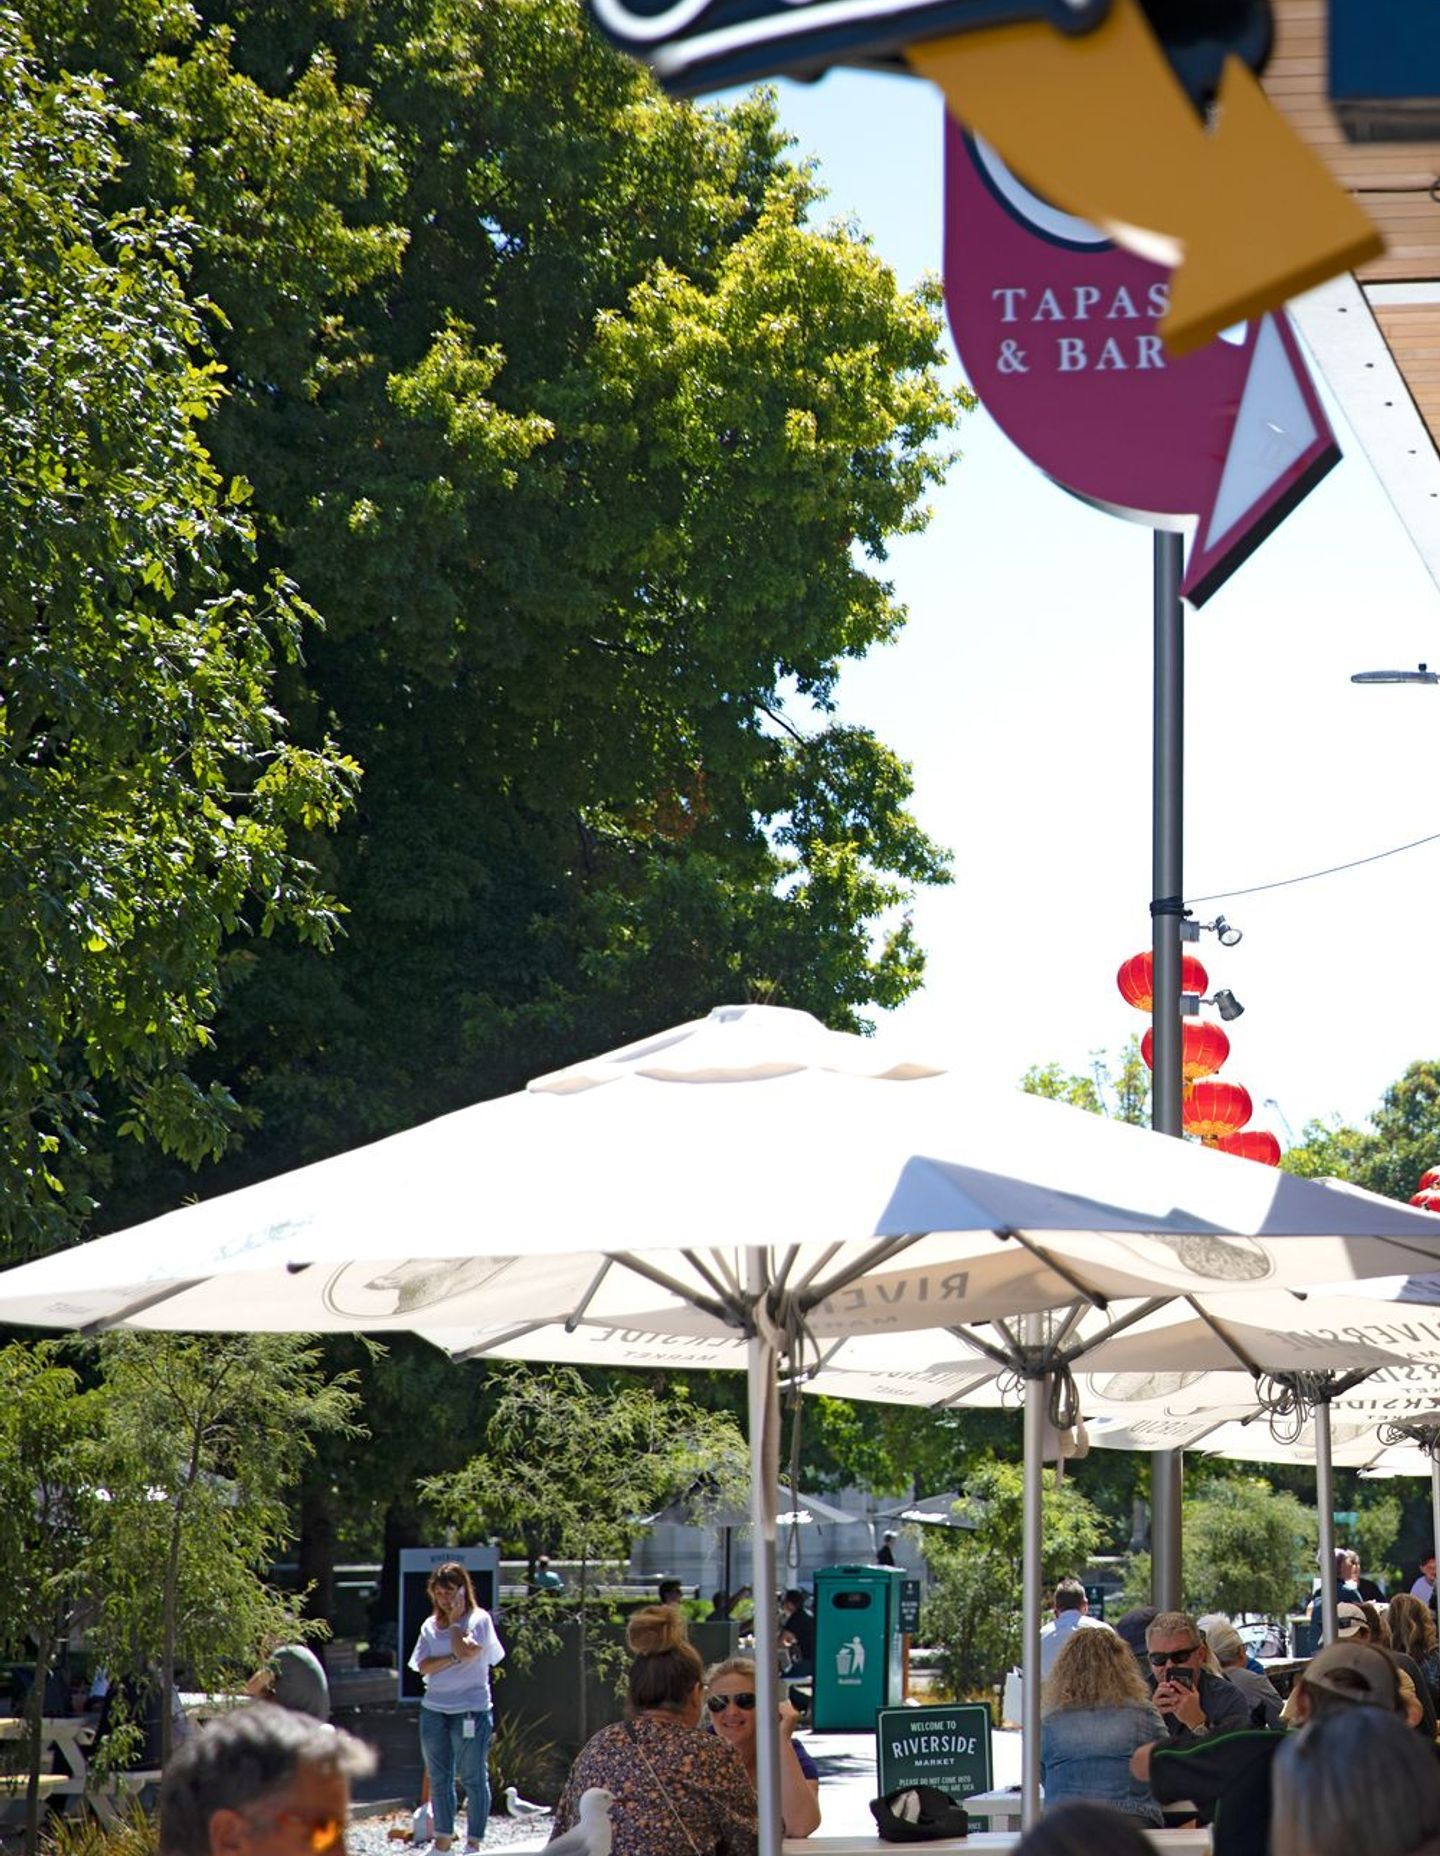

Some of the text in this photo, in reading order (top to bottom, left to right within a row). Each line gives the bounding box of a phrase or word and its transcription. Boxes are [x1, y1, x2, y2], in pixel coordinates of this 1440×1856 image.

[992, 283, 1172, 322] TAPAS
[996, 335, 1167, 374] & BAR
[910, 1720, 957, 1732] WELCOME TO
[892, 1735, 977, 1759] RIVERSIDE
[914, 1758, 955, 1767] MARKET
